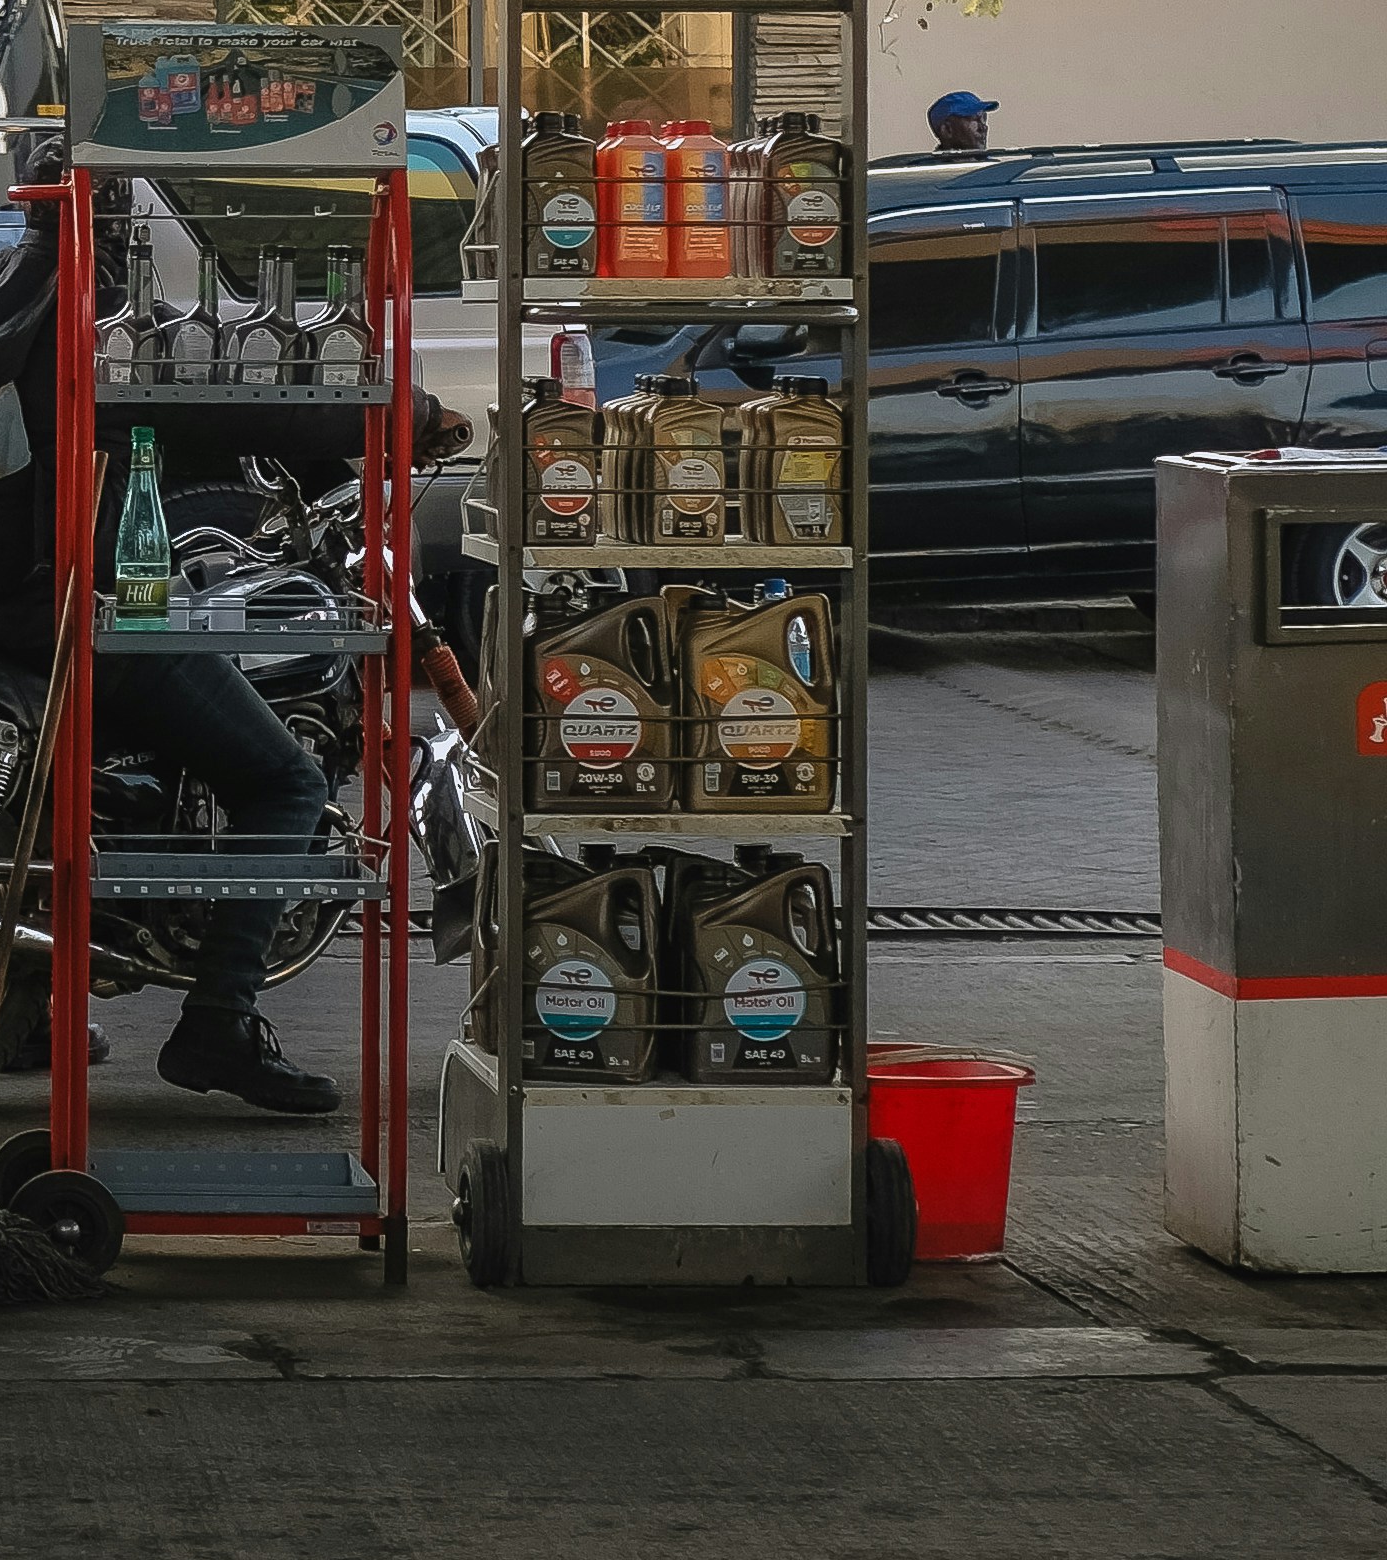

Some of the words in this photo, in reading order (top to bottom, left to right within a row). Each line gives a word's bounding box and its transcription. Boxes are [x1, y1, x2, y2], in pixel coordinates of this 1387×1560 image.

[198, 37, 213, 46] to
[217, 36, 259, 46] make
[263, 38, 297, 48] your
[126, 582, 155, 602] Hill
[563, 724, 639, 737] QUARTZ
[720, 724, 798, 737] QUARTZ
[578, 773, 623, 783] 20W-50
[545, 995, 584, 1008] Motor
[586, 997, 605, 1009] Oil
[734, 996, 773, 1008] Motor
[775, 996, 795, 1008] Oil
[554, 1048, 577, 1059] SAE
[744, 1049, 768, 1060] SAE
